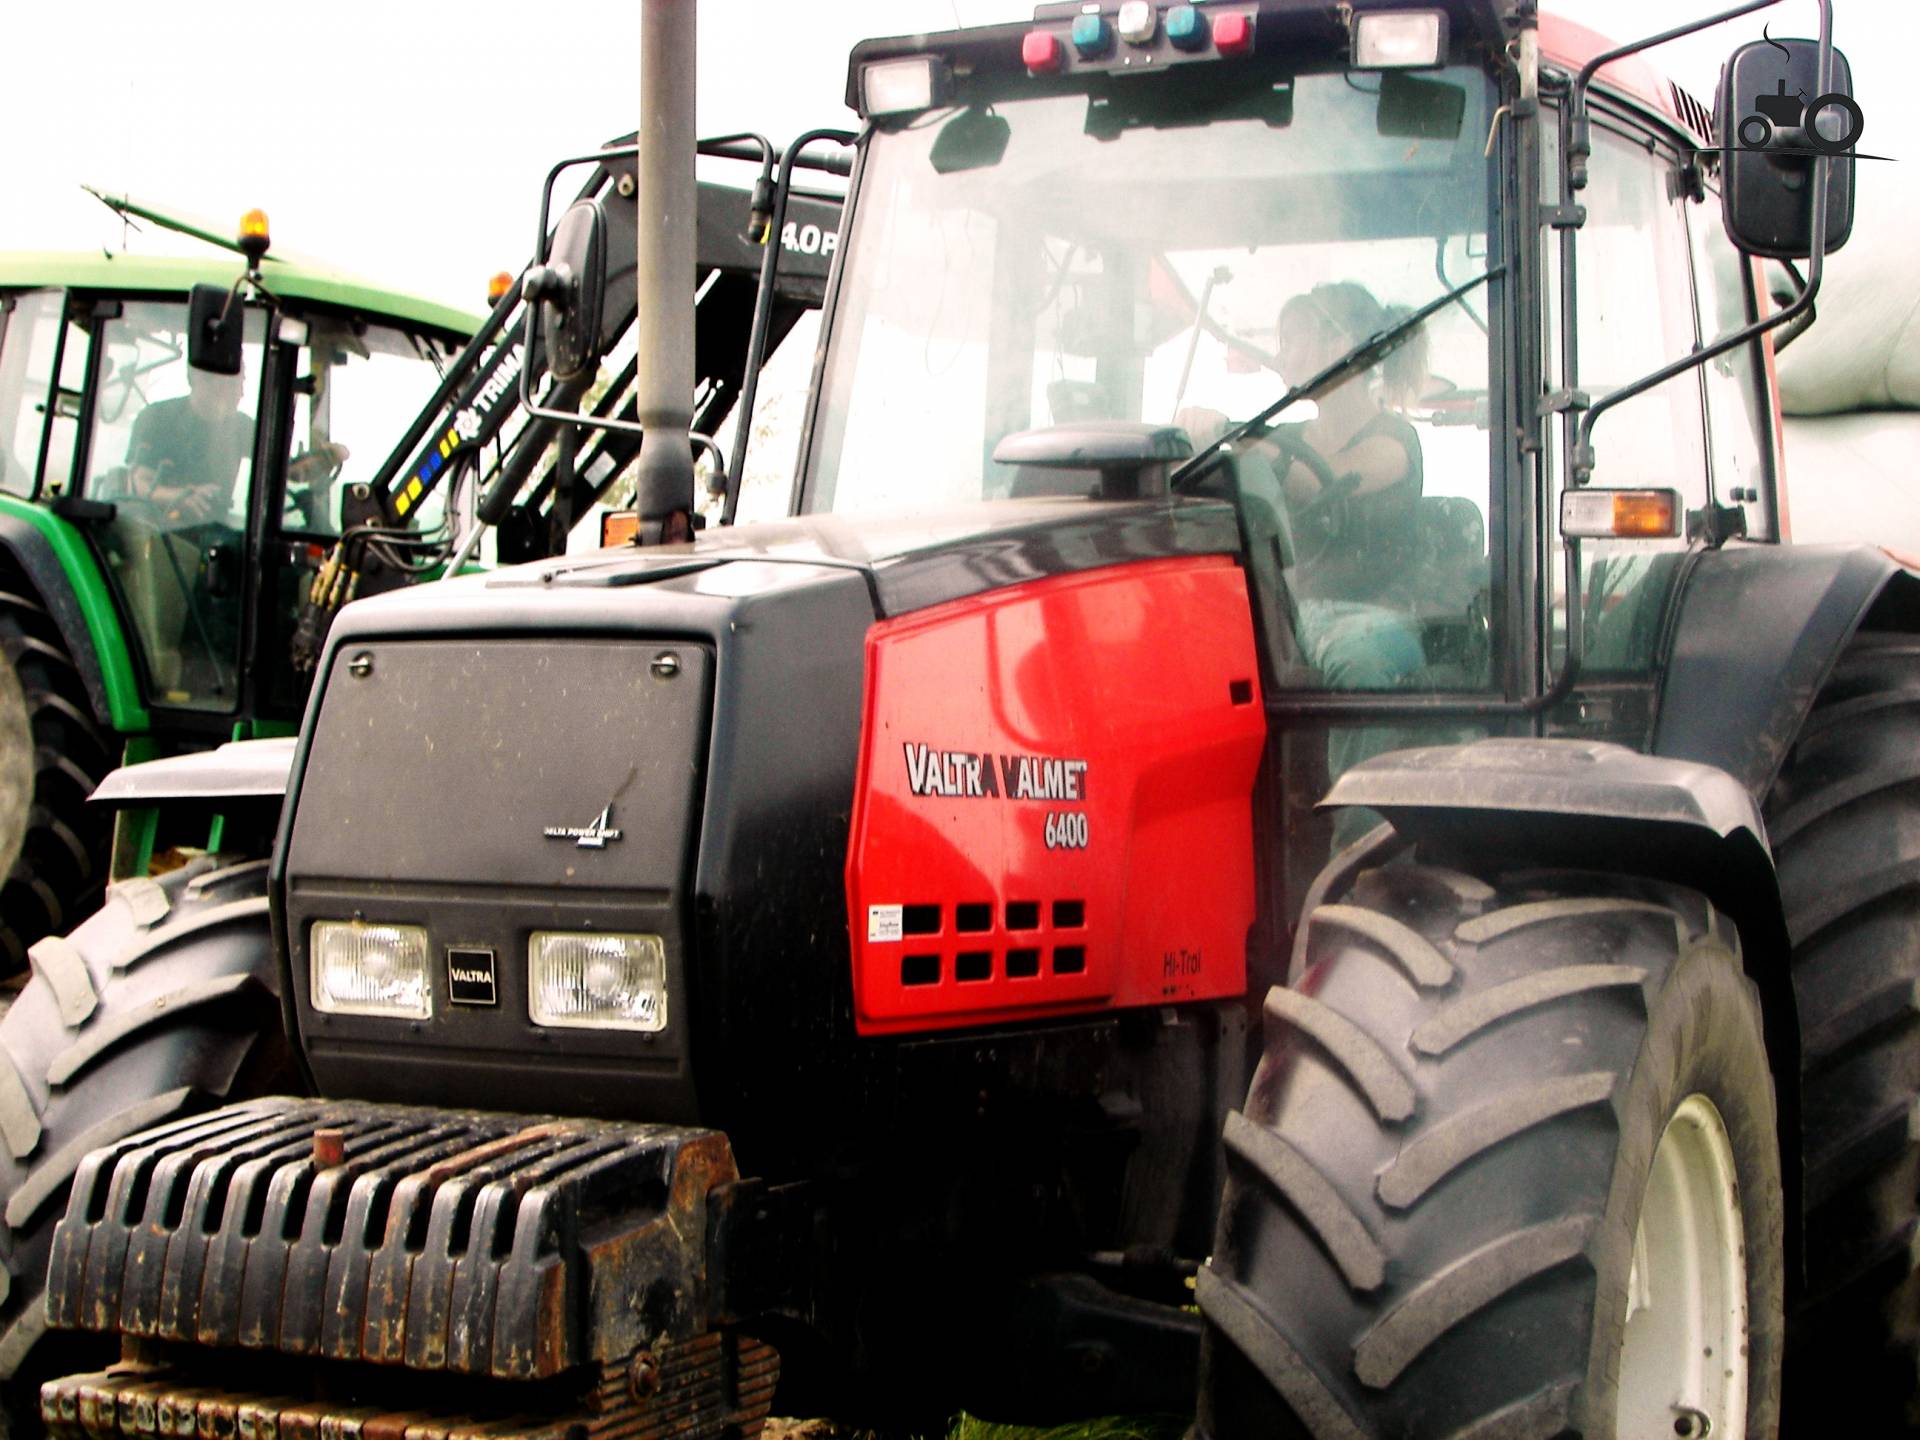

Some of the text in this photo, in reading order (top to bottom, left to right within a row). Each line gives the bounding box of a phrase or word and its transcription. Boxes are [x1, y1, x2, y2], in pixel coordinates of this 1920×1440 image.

[472, 343, 525, 413] TRIMA
[903, 742, 1088, 800] VALTRA VALMET
[1045, 812, 1090, 849] 6400
[451, 968, 492, 983] VALTRA
